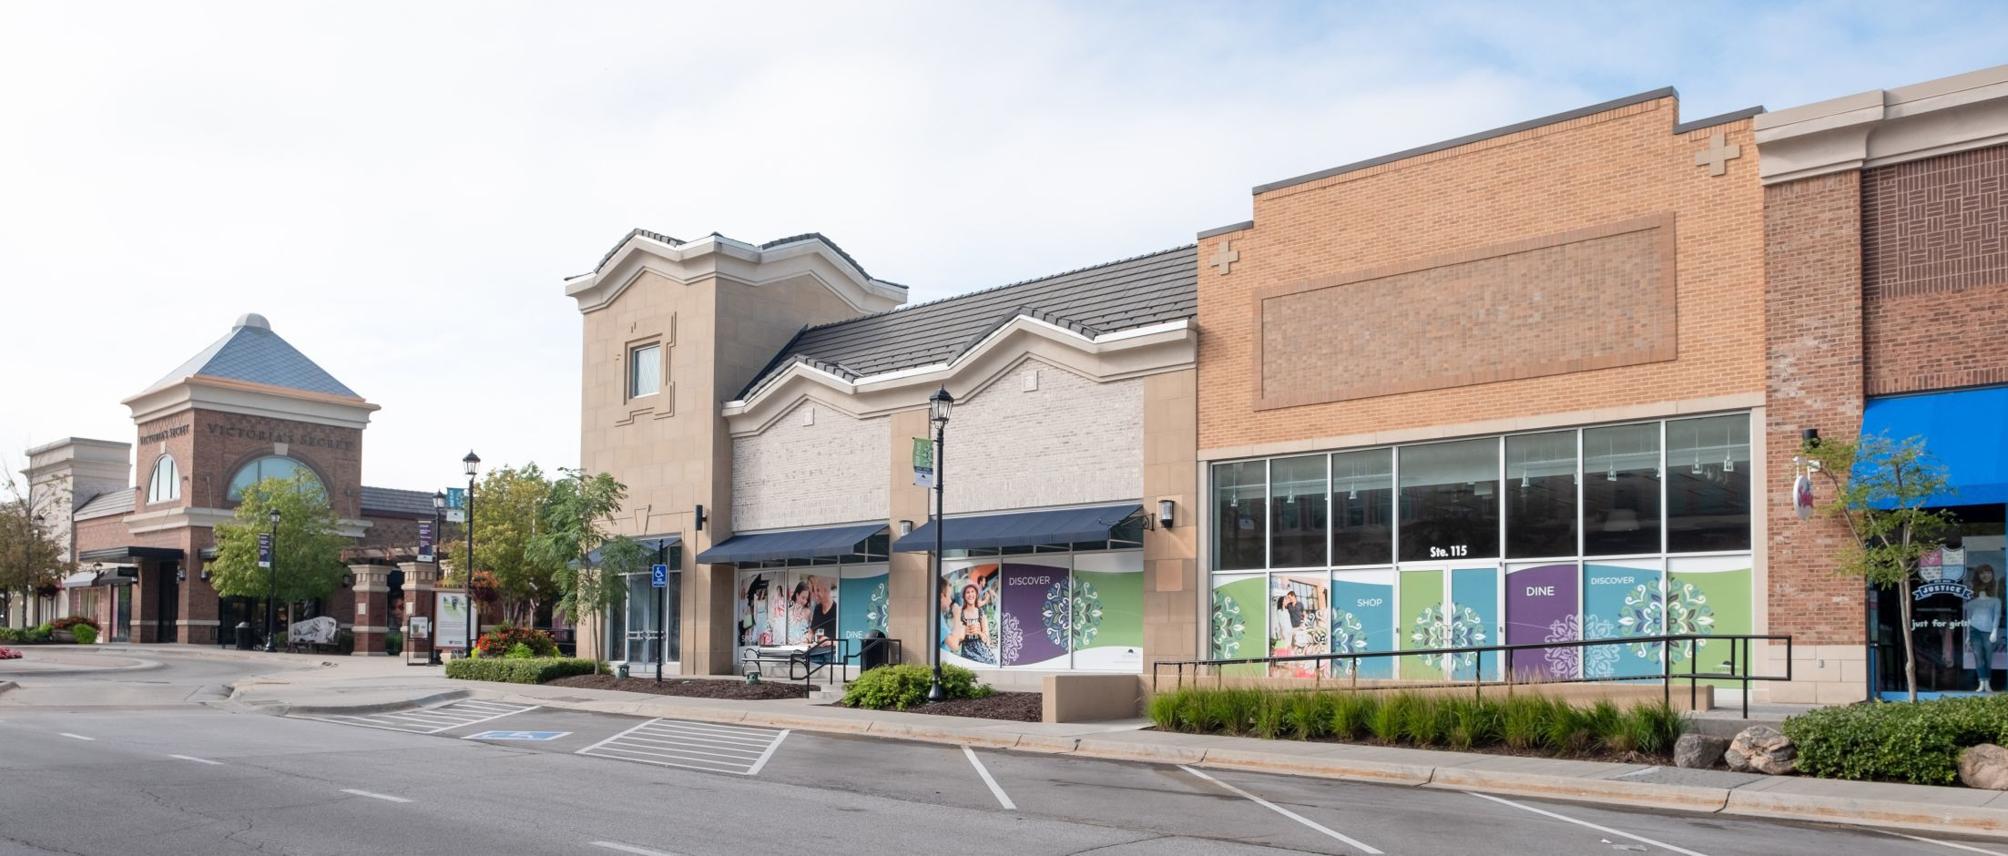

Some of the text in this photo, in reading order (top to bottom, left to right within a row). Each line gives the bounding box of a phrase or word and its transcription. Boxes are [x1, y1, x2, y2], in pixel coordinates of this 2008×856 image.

[169, 424, 190, 438] SECRET
[207, 423, 353, 450] VICTORIA'S SECRET
[1430, 545, 1467, 557] Ste. 115
[1008, 575, 1051, 586] DISCOVER
[1591, 576, 1635, 585] DISCOVER
[1526, 586, 1555, 597] DINE
[1922, 585, 1962, 594] JUSTICE
[1356, 598, 1383, 607] SHOP
[1911, 619, 1929, 631] just
[1931, 619, 1947, 628] for
[845, 630, 864, 639] DINE
